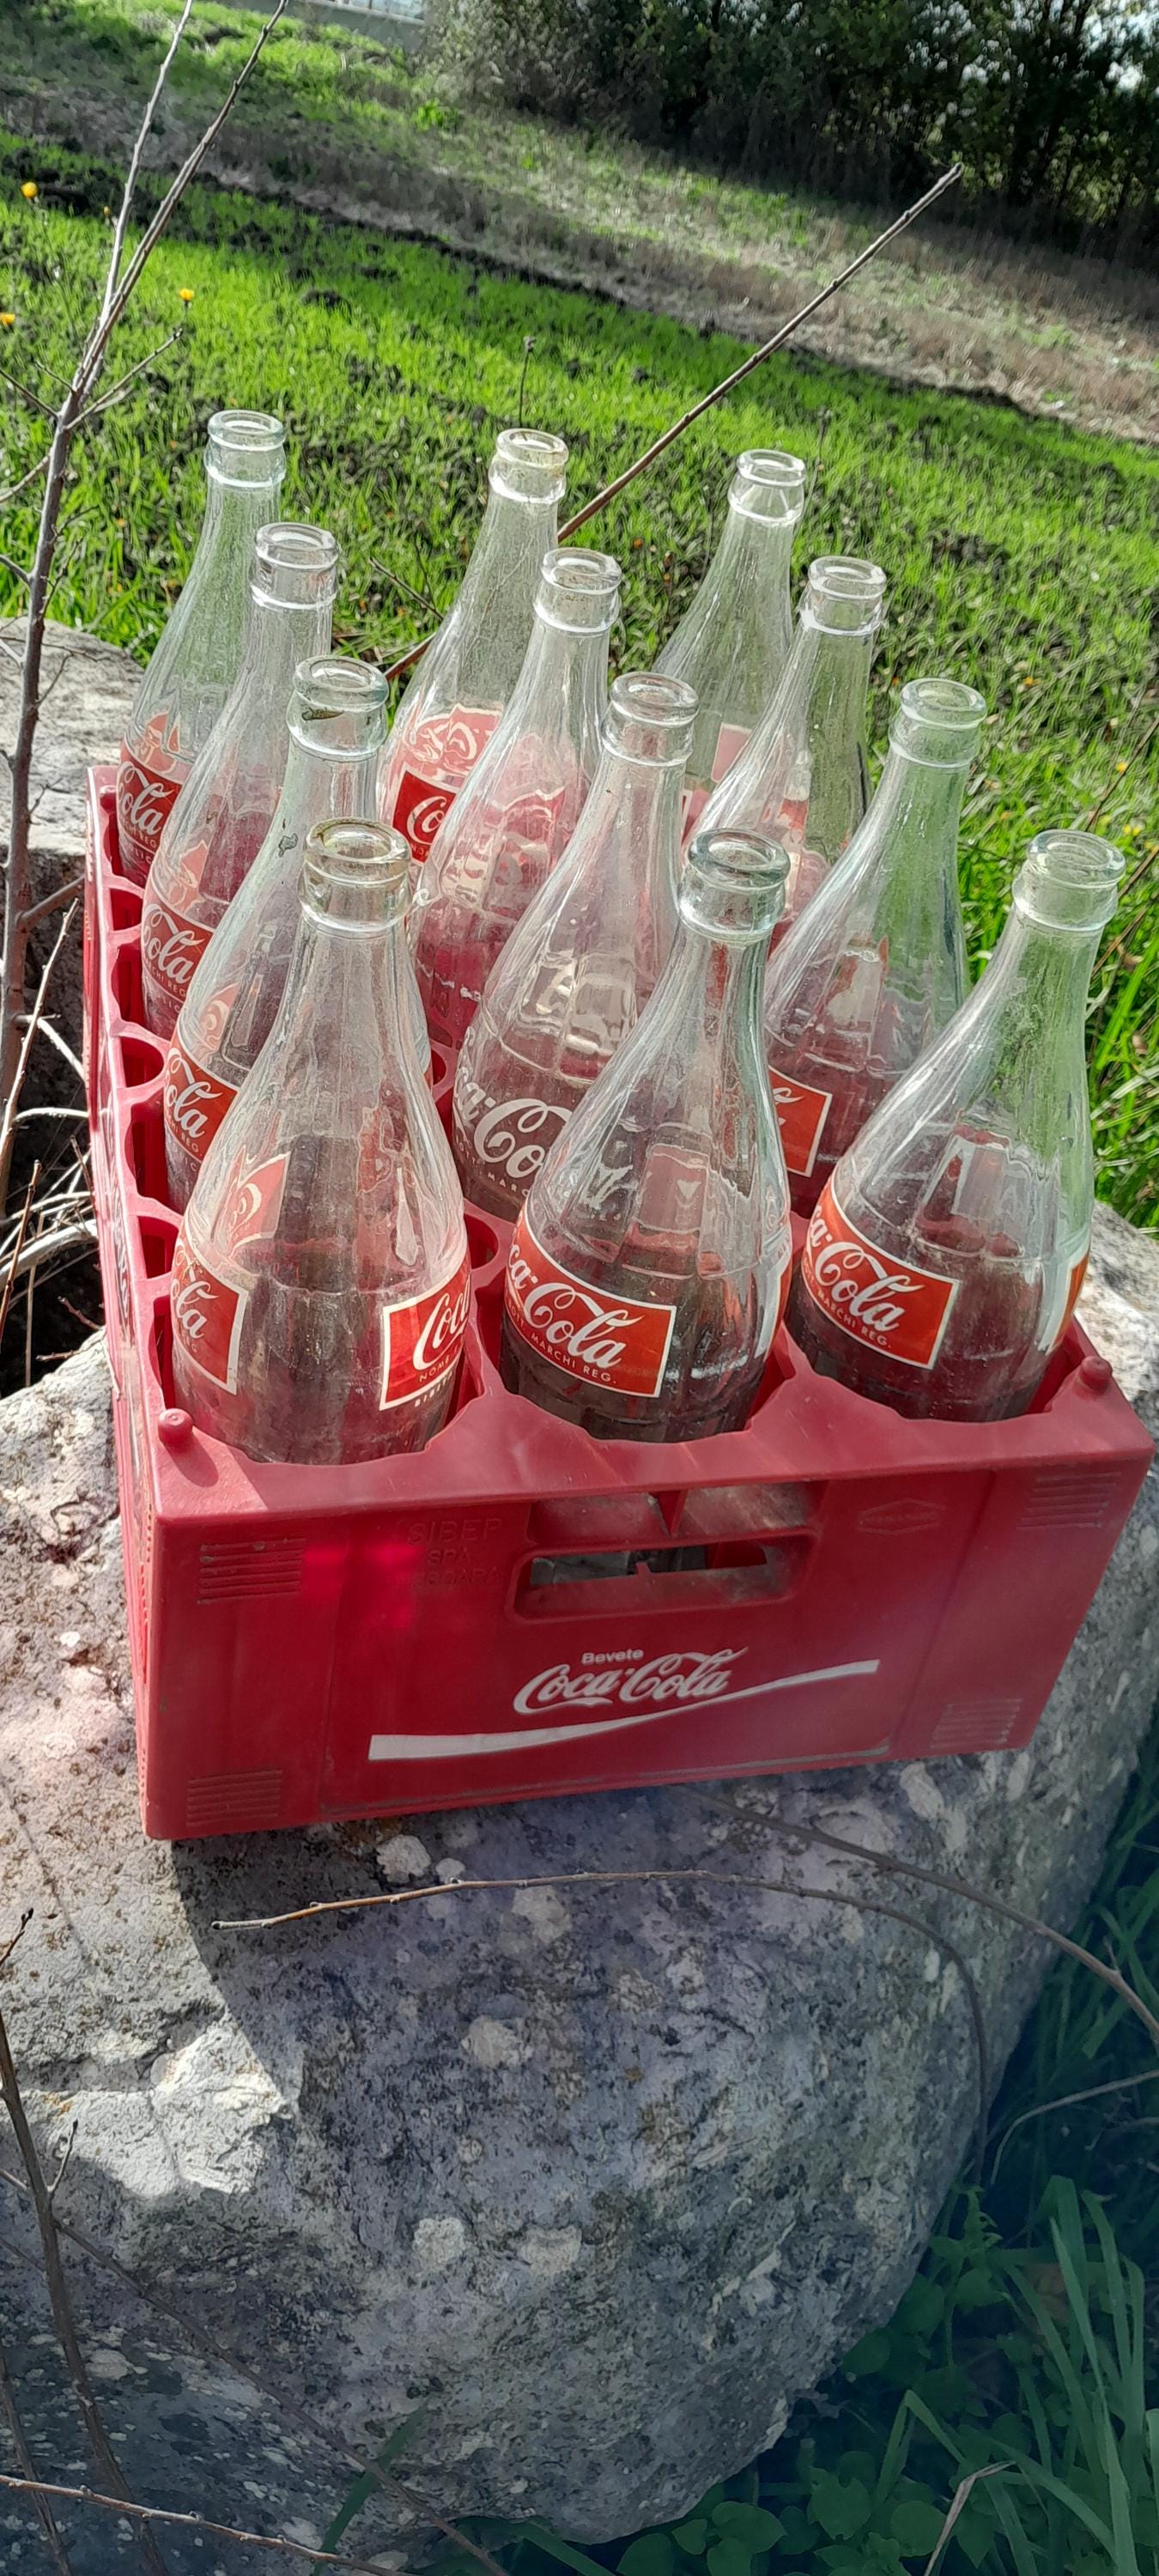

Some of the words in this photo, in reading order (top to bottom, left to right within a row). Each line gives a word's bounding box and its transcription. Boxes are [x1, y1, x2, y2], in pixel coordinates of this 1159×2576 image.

[860, 1326, 892, 1350] REG.
[531, 1332, 576, 1369] MARCHI
[583, 1364, 617, 1384] REG.
[407, 1517, 503, 1546] SIBEP
[427, 1546, 471, 1565] SPA
[581, 1649, 644, 1666] Bevete
[513, 1646, 749, 1715] Coca-Cola
